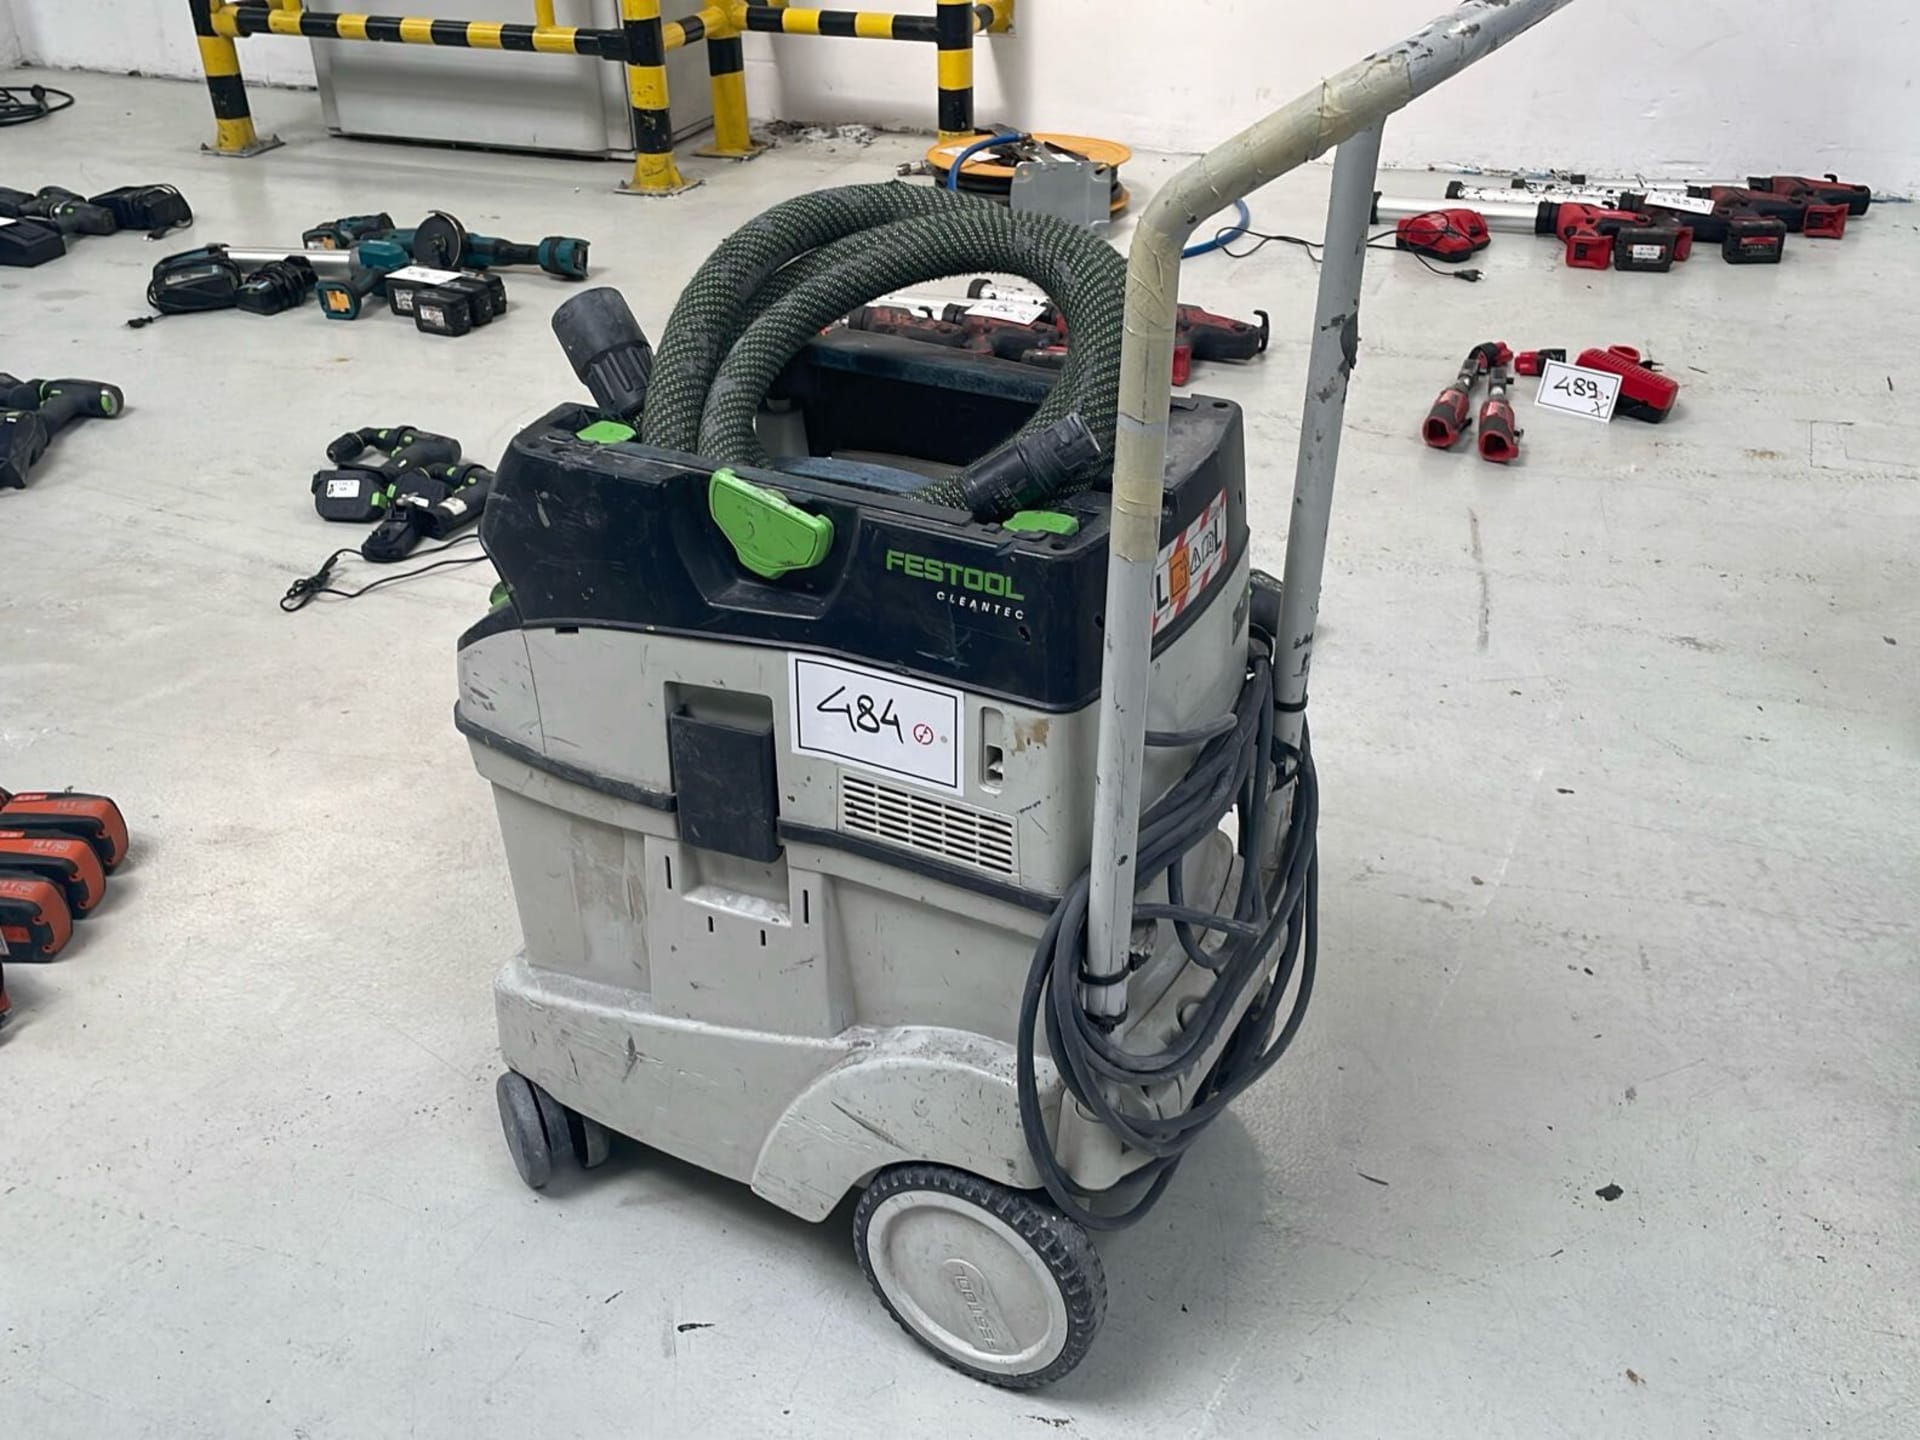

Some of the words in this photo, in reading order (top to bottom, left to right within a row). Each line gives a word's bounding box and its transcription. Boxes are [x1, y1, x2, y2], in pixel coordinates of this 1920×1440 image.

[1553, 375, 1599, 400] 489
[885, 549, 1025, 601] FESTOOL
[936, 591, 1025, 620] CLEANTEC
[816, 685, 905, 745] 484
